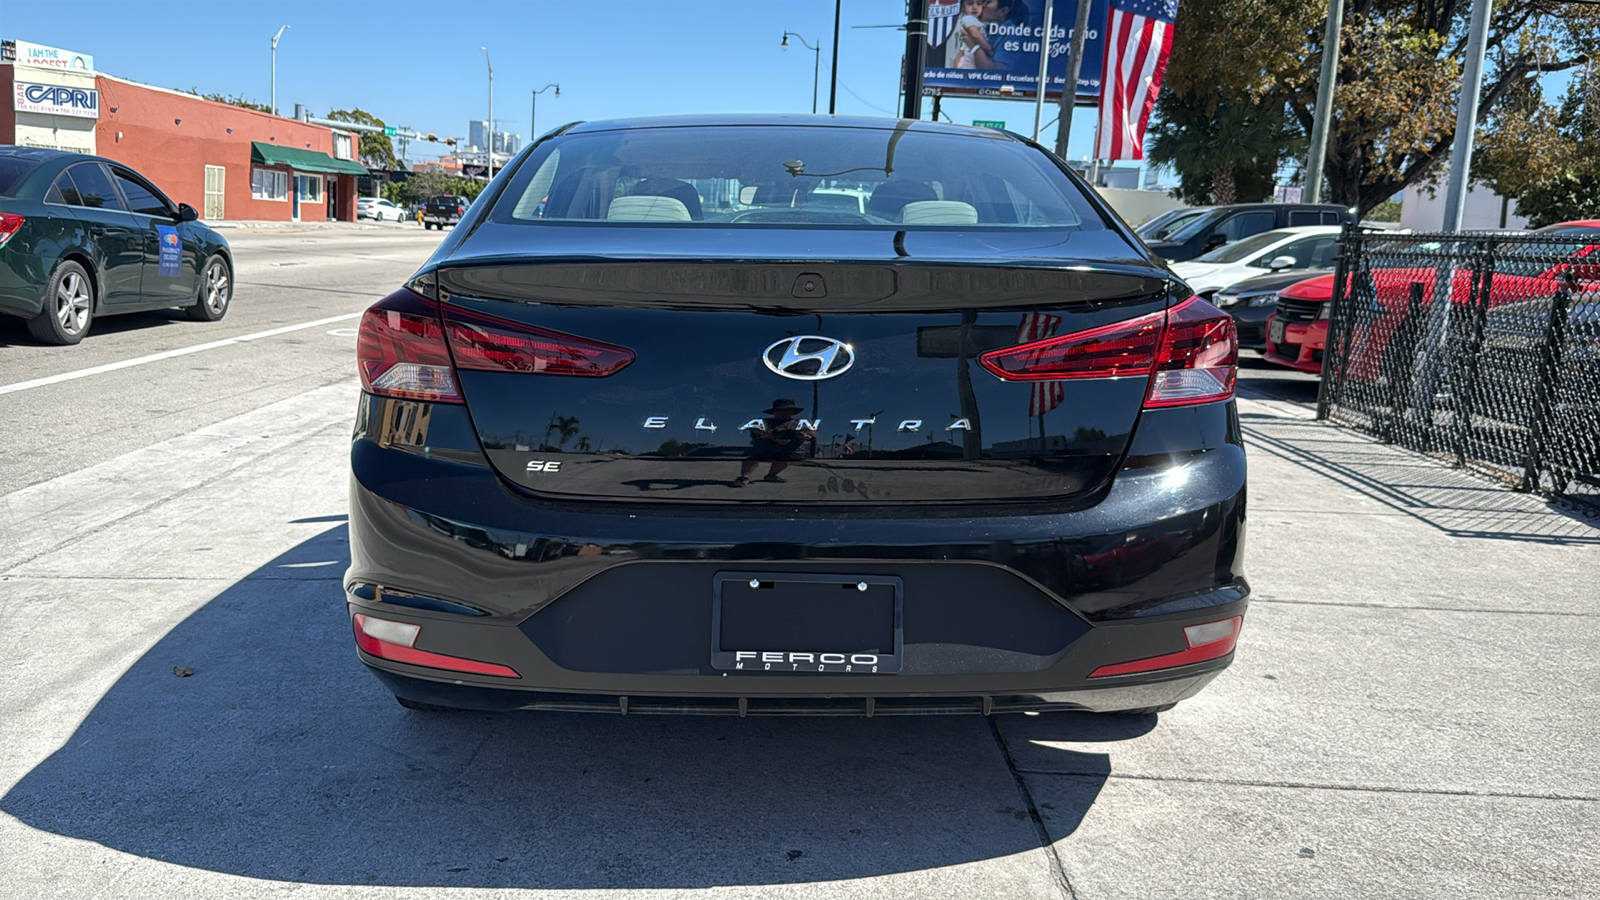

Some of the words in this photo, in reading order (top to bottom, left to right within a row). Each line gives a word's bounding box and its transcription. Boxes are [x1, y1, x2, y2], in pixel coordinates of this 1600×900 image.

[989, 22, 1031, 36] Donde
[1034, 25, 1065, 38] cda
[1068, 26, 1098, 40] no
[1004, 41, 1019, 52] es
[1023, 42, 1039, 52] un
[33, 49, 43, 58] AM
[45, 50, 58, 58] THE
[968, 72, 982, 80] VPK
[983, 73, 1002, 81] Gratis
[1006, 74, 1034, 82] Escuelas
[16, 84, 24, 104] BAR
[25, 85, 96, 109] CAPRI
[643, 416, 972, 432] ELANTRA
[526, 460, 561, 472] SE
[736, 651, 878, 664] FERCO
[736, 662, 878, 673] MOTORS
